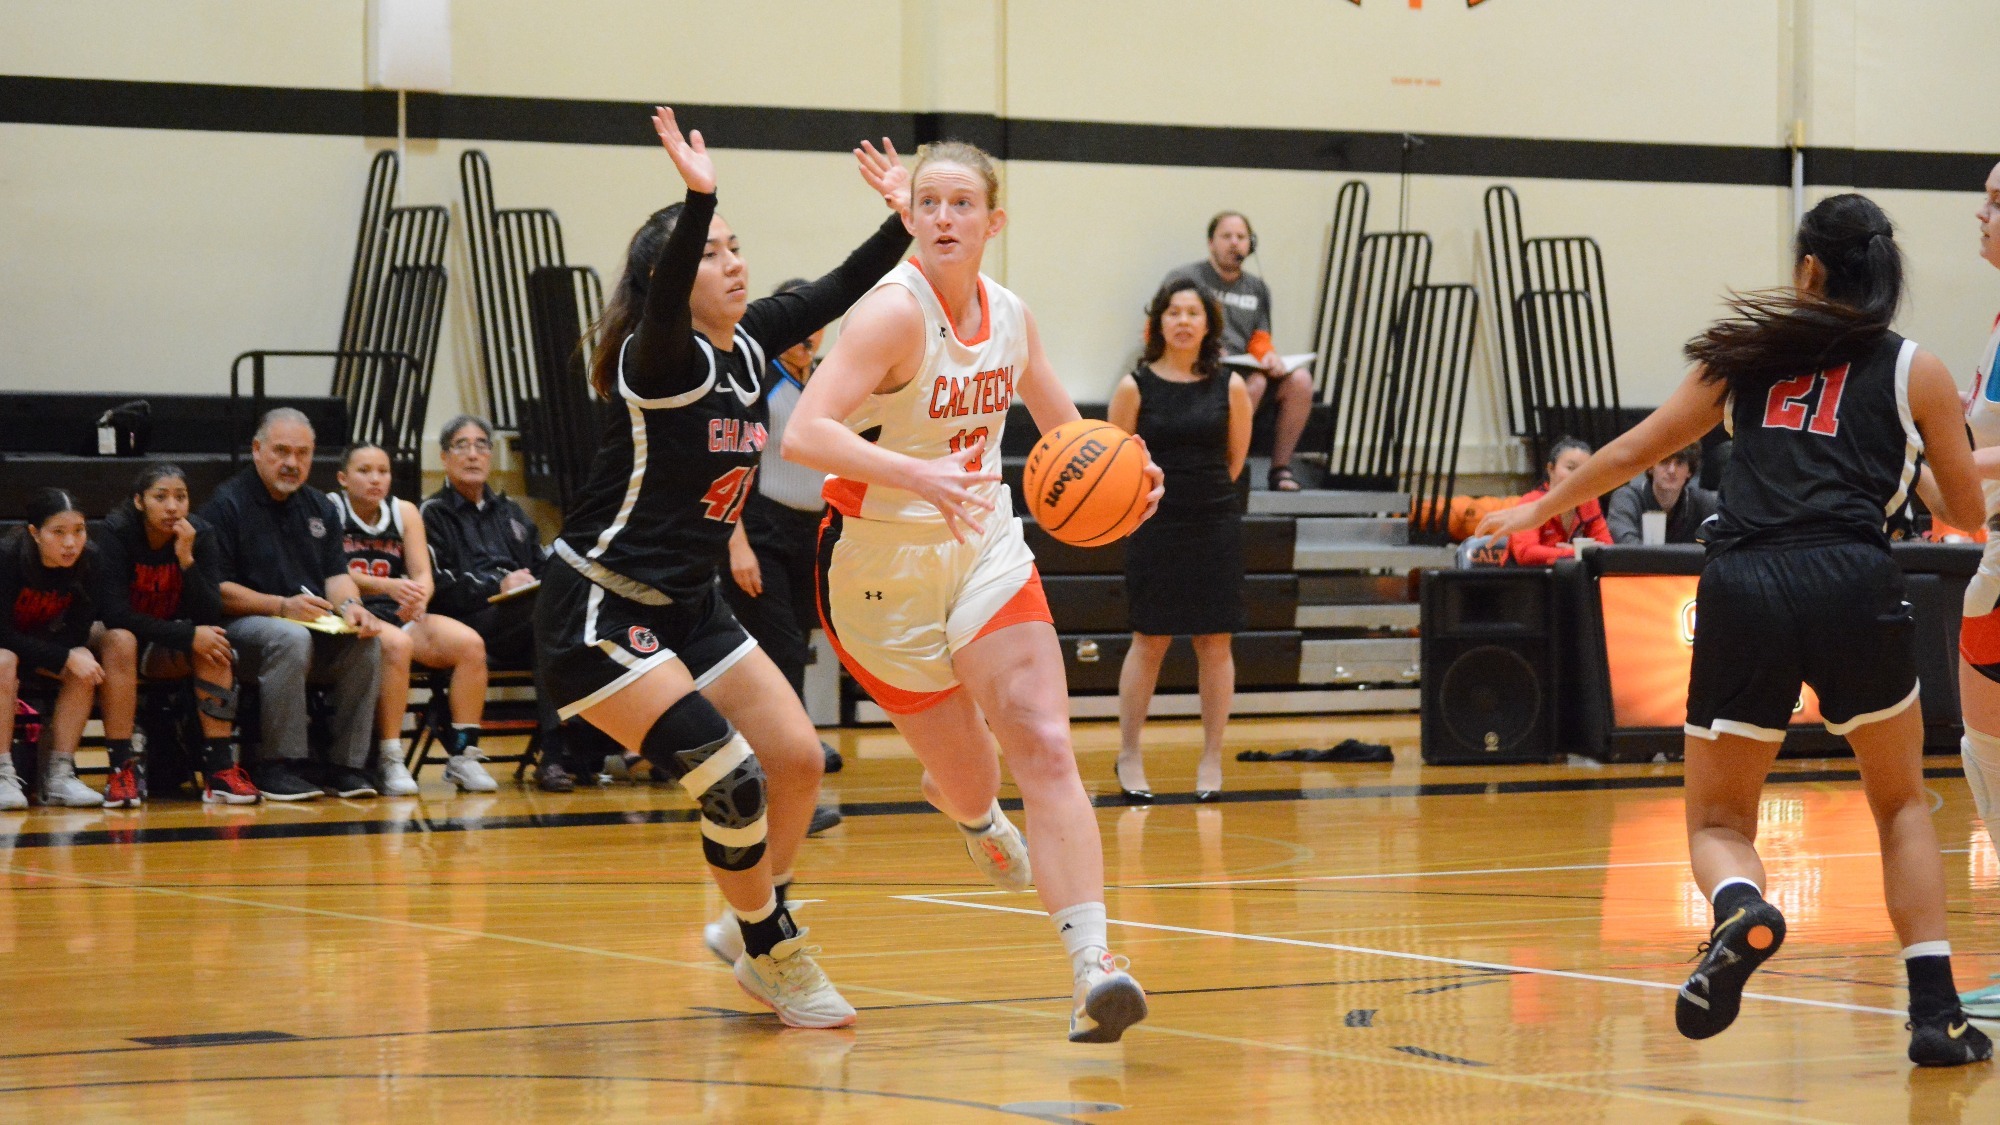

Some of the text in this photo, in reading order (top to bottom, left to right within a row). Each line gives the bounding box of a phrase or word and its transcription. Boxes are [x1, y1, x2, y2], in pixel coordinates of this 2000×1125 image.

[929, 365, 1014, 418] CALTECH
[1762, 362, 1851, 437] 21
[700, 465, 758, 523] 41
[1045, 439, 1108, 507] Wilson
